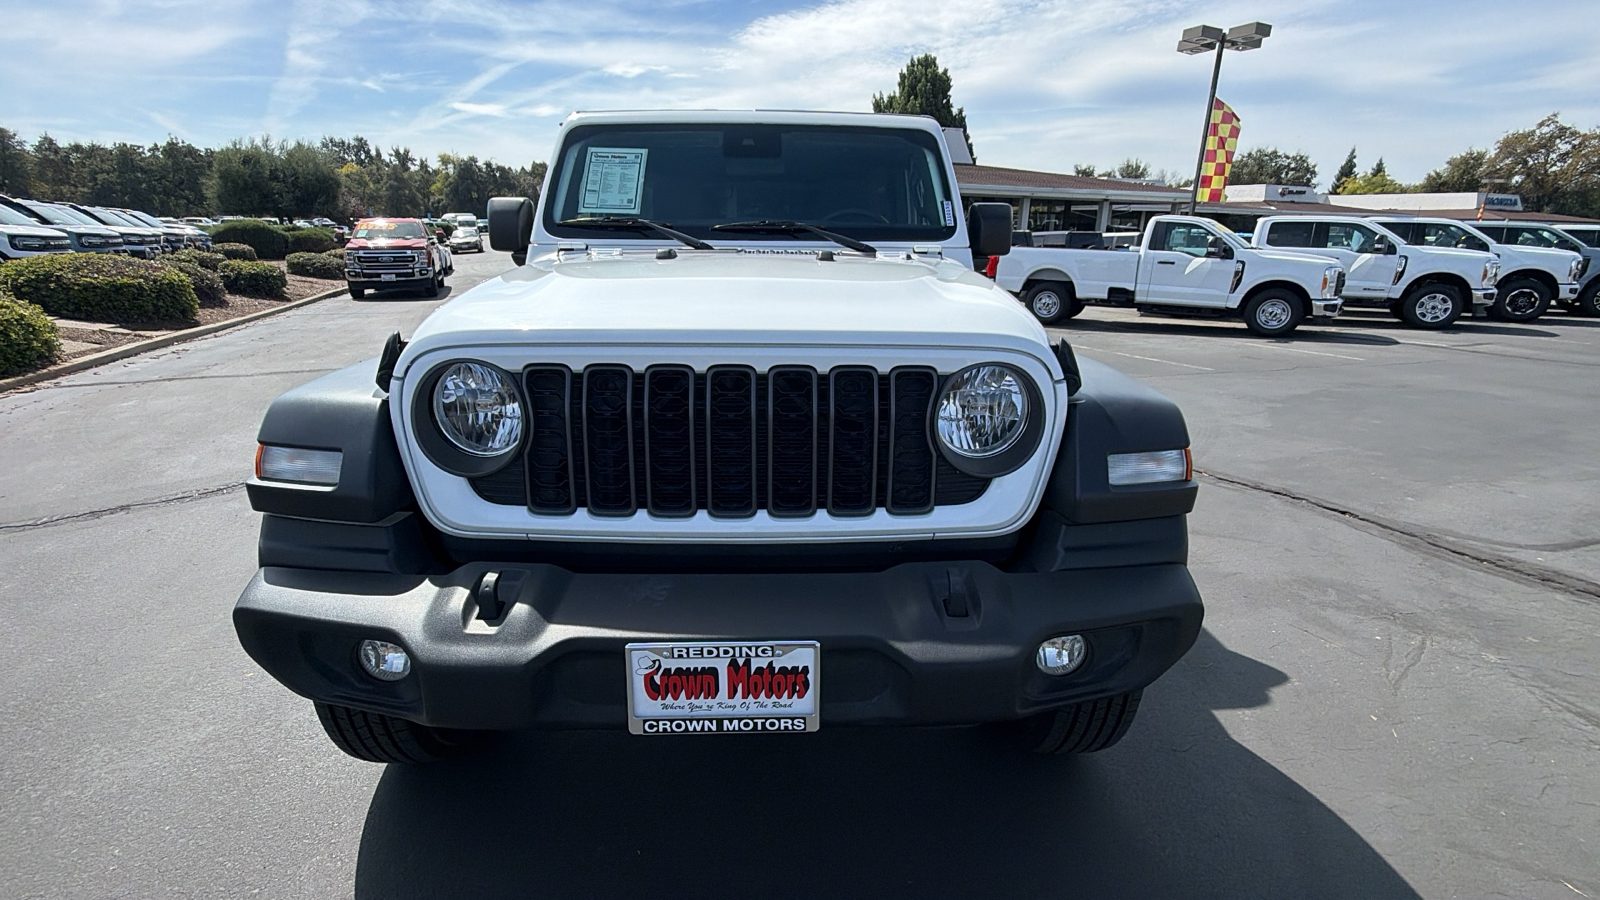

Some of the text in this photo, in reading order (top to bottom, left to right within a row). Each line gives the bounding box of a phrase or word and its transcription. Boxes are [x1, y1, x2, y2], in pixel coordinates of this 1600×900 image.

[673, 646, 773, 658] REDDING
[643, 658, 810, 701] Crown Motors
[687, 702, 714, 711] You're
[717, 702, 736, 710] King
[740, 701, 750, 710] Of
[754, 701, 768, 709] The
[771, 701, 793, 709] Road
[644, 718, 805, 732] CROWN MOTORS
